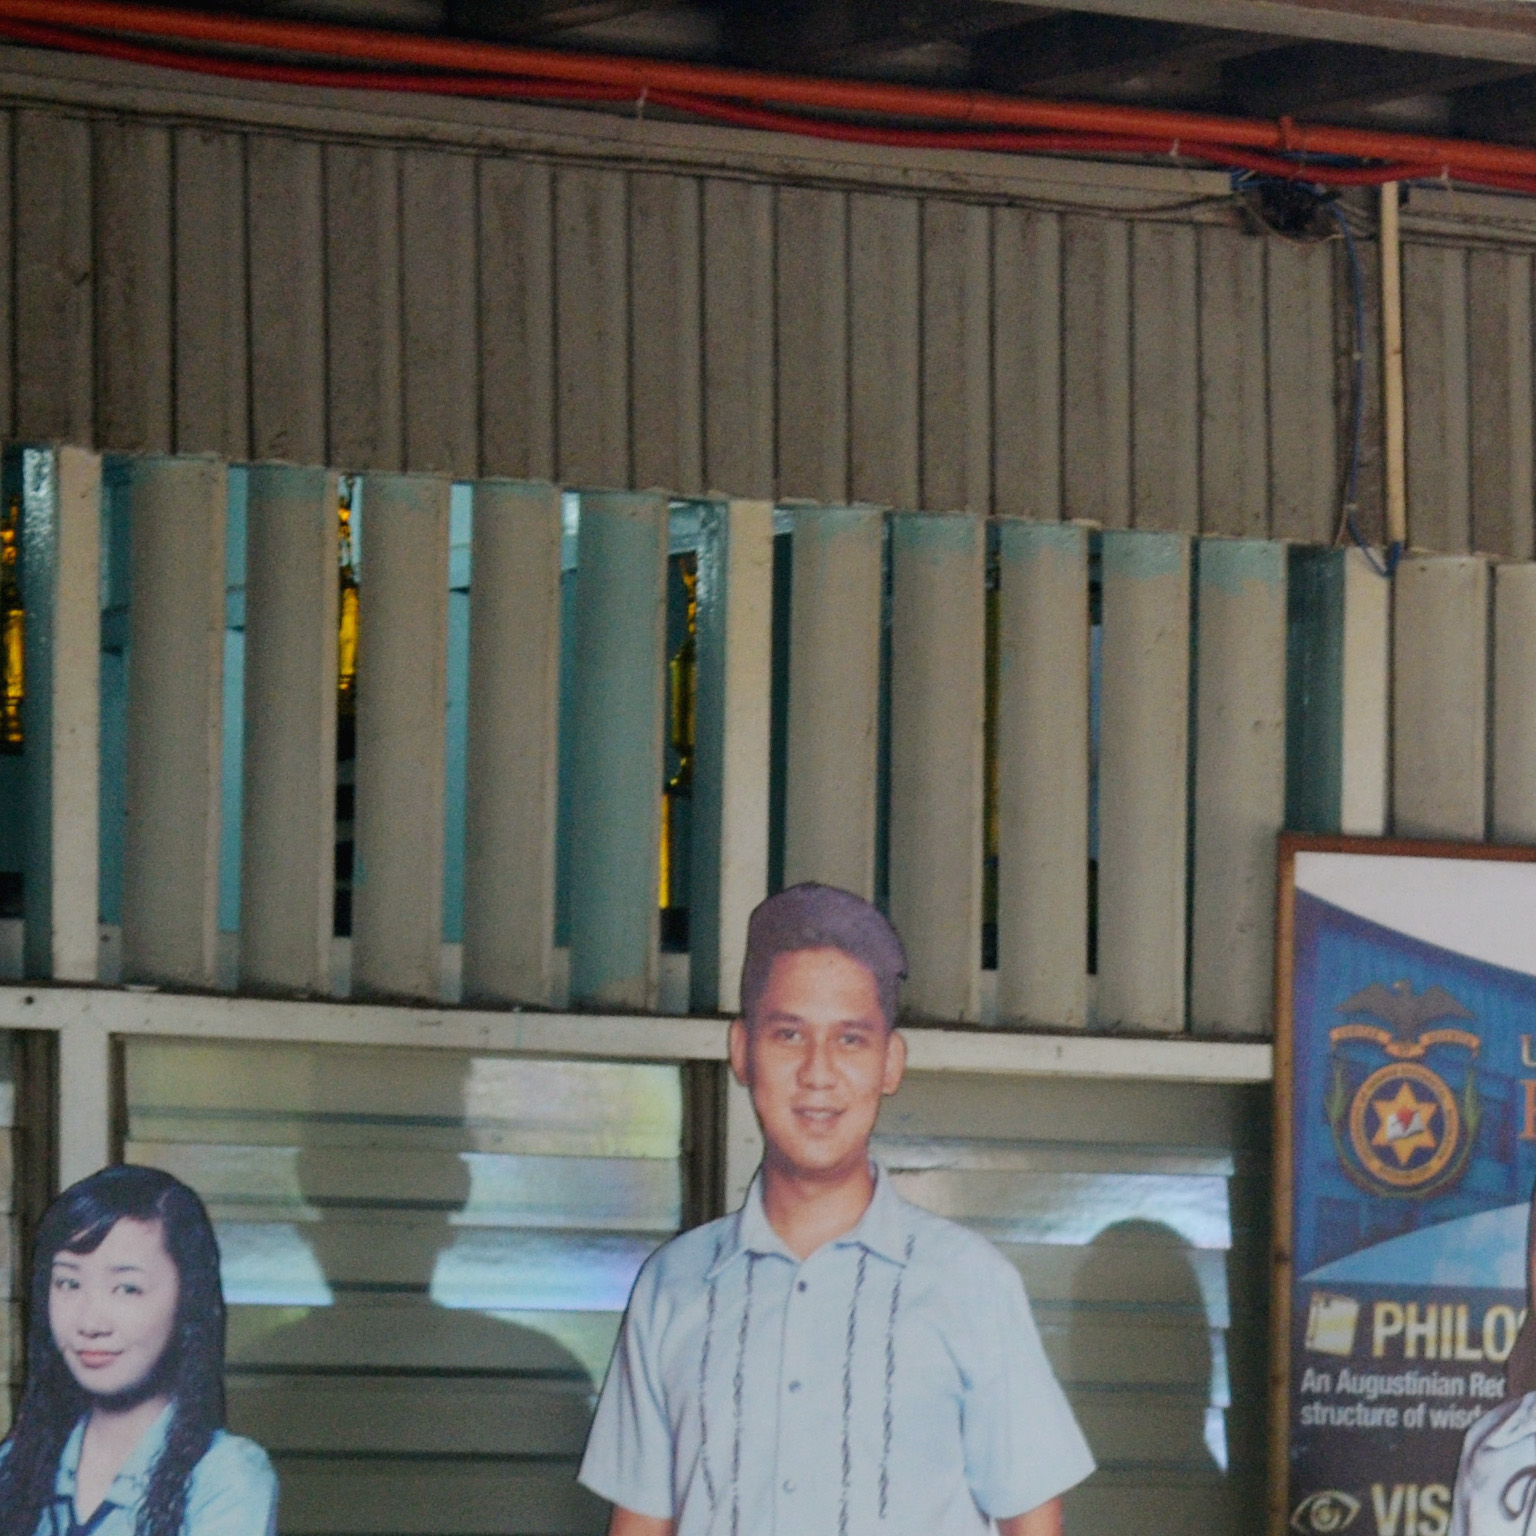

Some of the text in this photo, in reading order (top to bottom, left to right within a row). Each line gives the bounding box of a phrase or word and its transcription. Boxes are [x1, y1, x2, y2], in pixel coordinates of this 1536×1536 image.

[1300, 1368, 1330, 1395] An
[1335, 1369, 1466, 1400] Augustinian
[1300, 1404, 1397, 1428] structure
[1402, 1404, 1425, 1429] of
